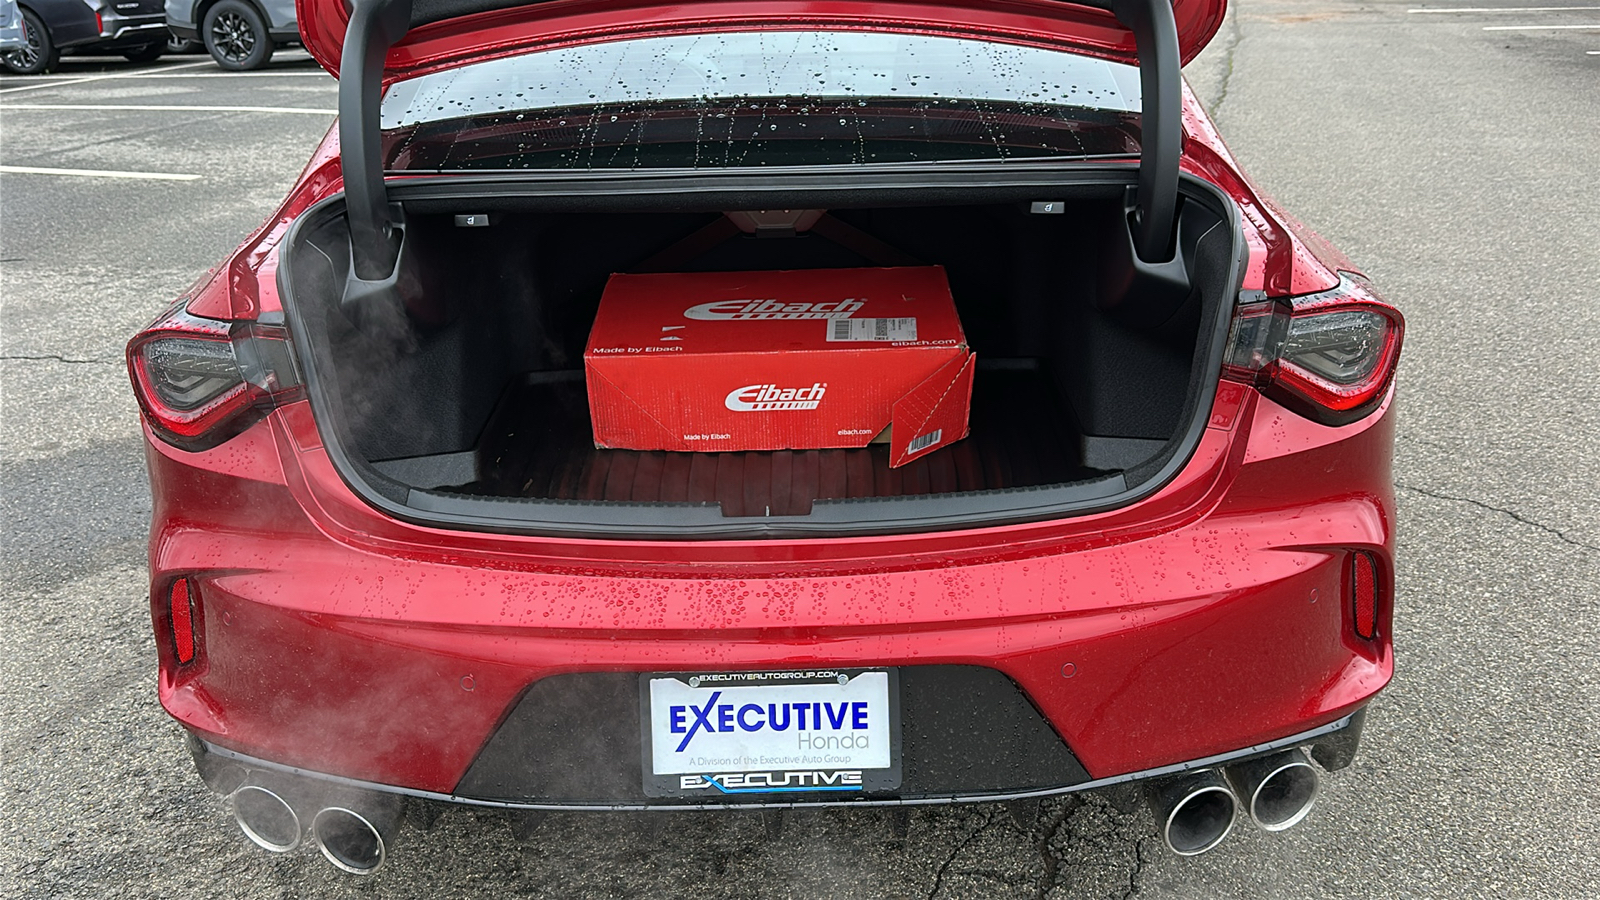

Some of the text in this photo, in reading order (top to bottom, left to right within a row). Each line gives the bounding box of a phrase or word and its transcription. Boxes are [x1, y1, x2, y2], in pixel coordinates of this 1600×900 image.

[683, 298, 865, 320] Eibach
[724, 383, 826, 412] Eibach
[699, 671, 839, 682] EXECUTIVEAUTOGROUP.COM
[670, 692, 868, 753] EXECUTIVE
[798, 732, 869, 750] Honda
[689, 754, 851, 766] A Division of the Executive Auto Group
[680, 771, 863, 793] EXECUTIVE
